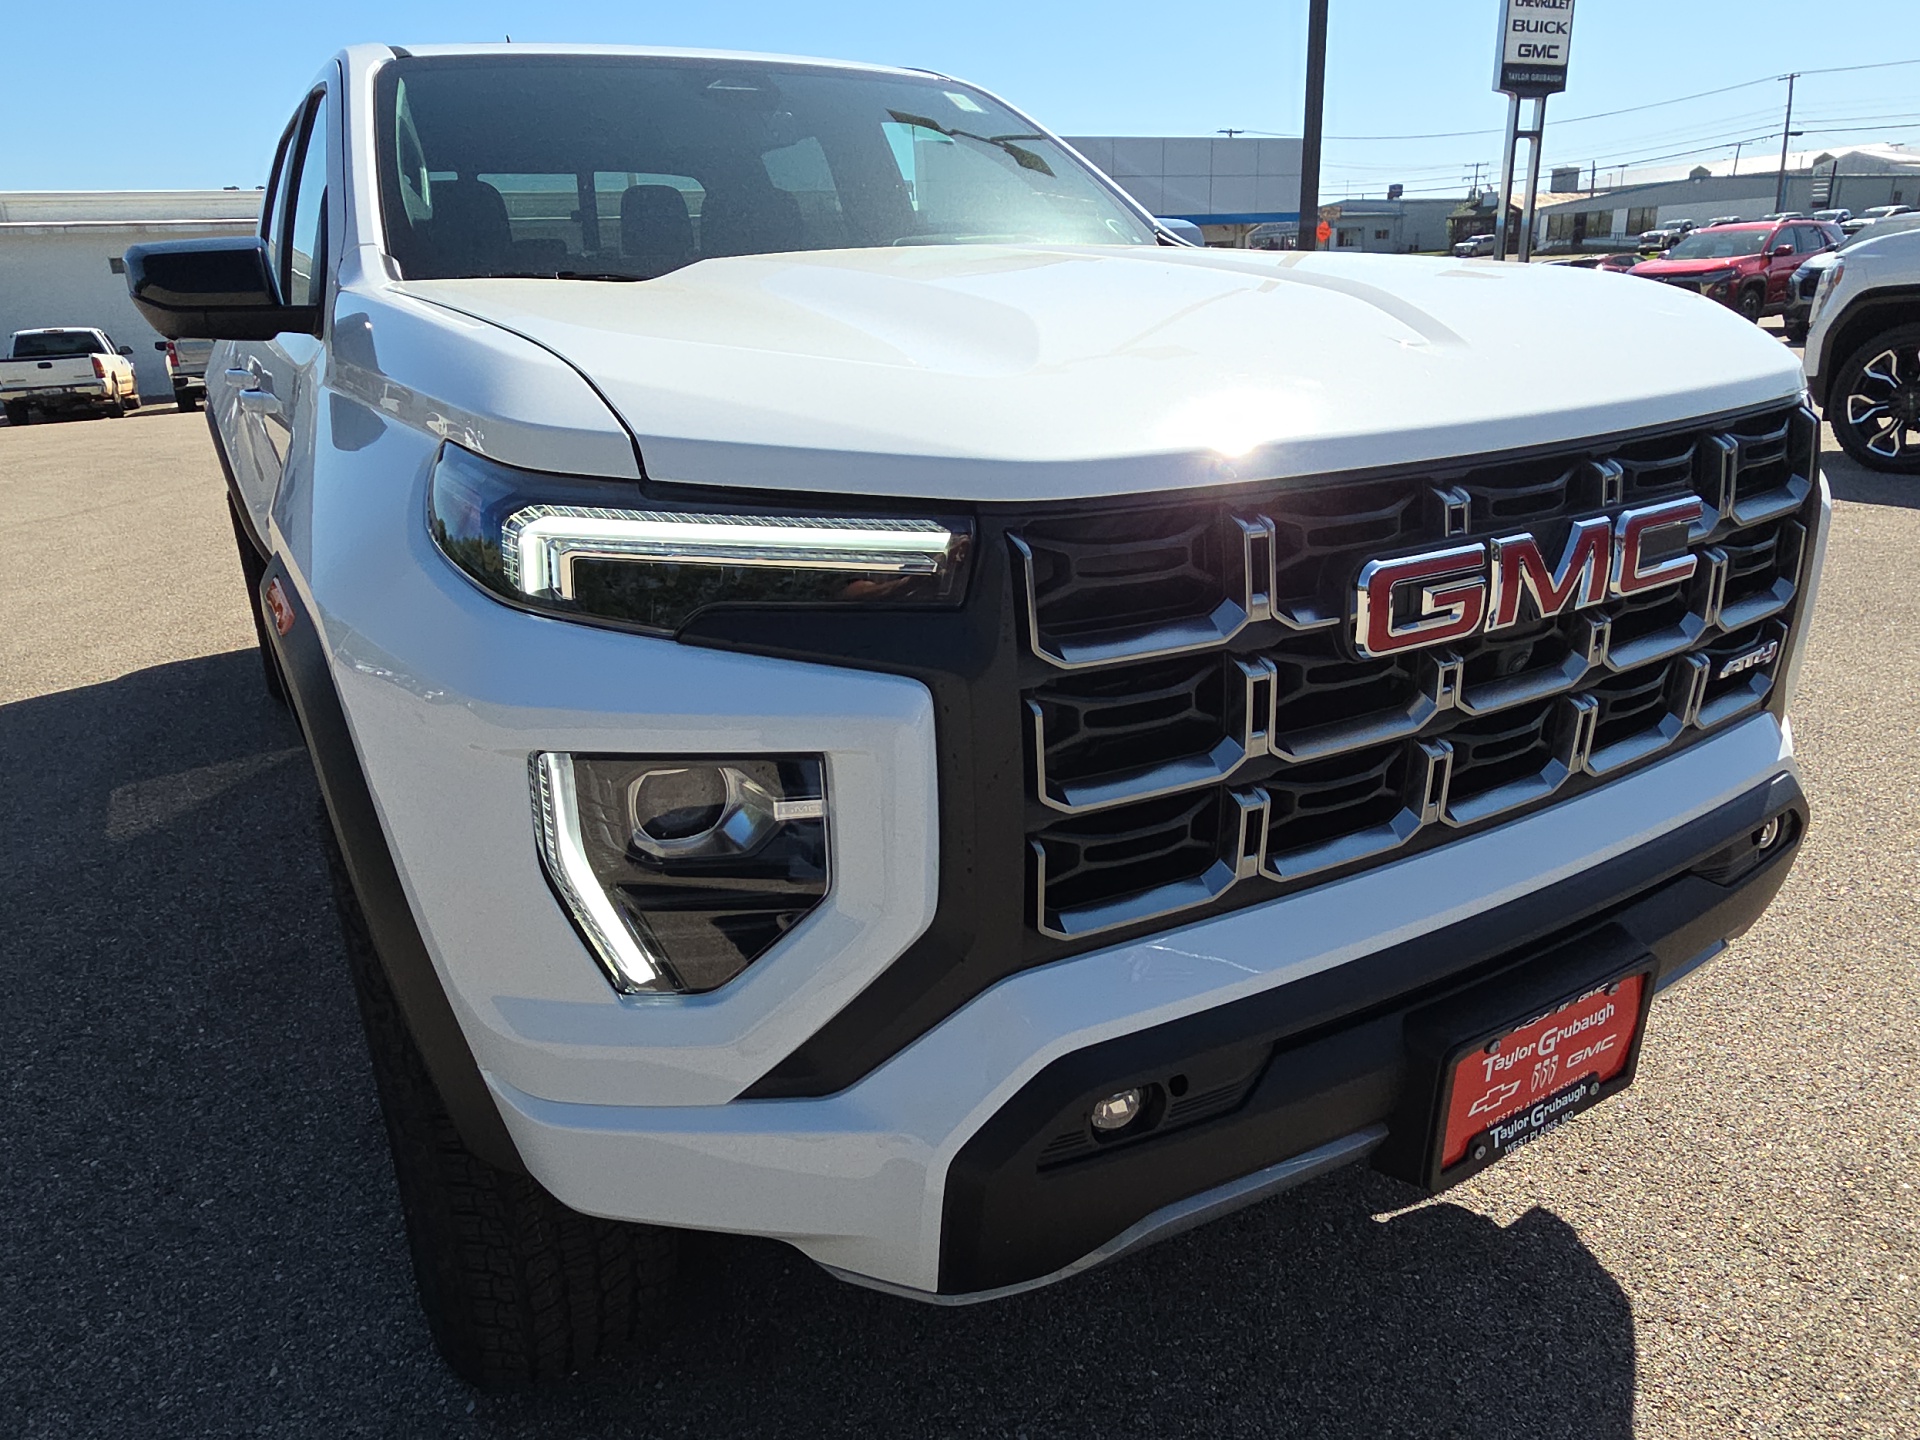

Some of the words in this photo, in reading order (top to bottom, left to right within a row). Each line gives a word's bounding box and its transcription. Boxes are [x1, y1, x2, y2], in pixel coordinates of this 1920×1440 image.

[1512, 19, 1568, 34] BUICK
[1517, 43, 1560, 59] GMC
[1508, 72, 1530, 81] TAYLOR
[1356, 495, 1703, 659] GMC
[1719, 641, 1778, 679] AT4
[1482, 1042, 1536, 1082] Taylor
[1538, 1002, 1615, 1056] Grubaugh
[1566, 1033, 1617, 1069] GMC
[1486, 1109, 1513, 1128] WEST
[1489, 1116, 1530, 1149] Taylor
[1530, 1083, 1587, 1127] Grubaugh
[1504, 1135, 1529, 1154] WEST
[1561, 1110, 1574, 1124] MO
